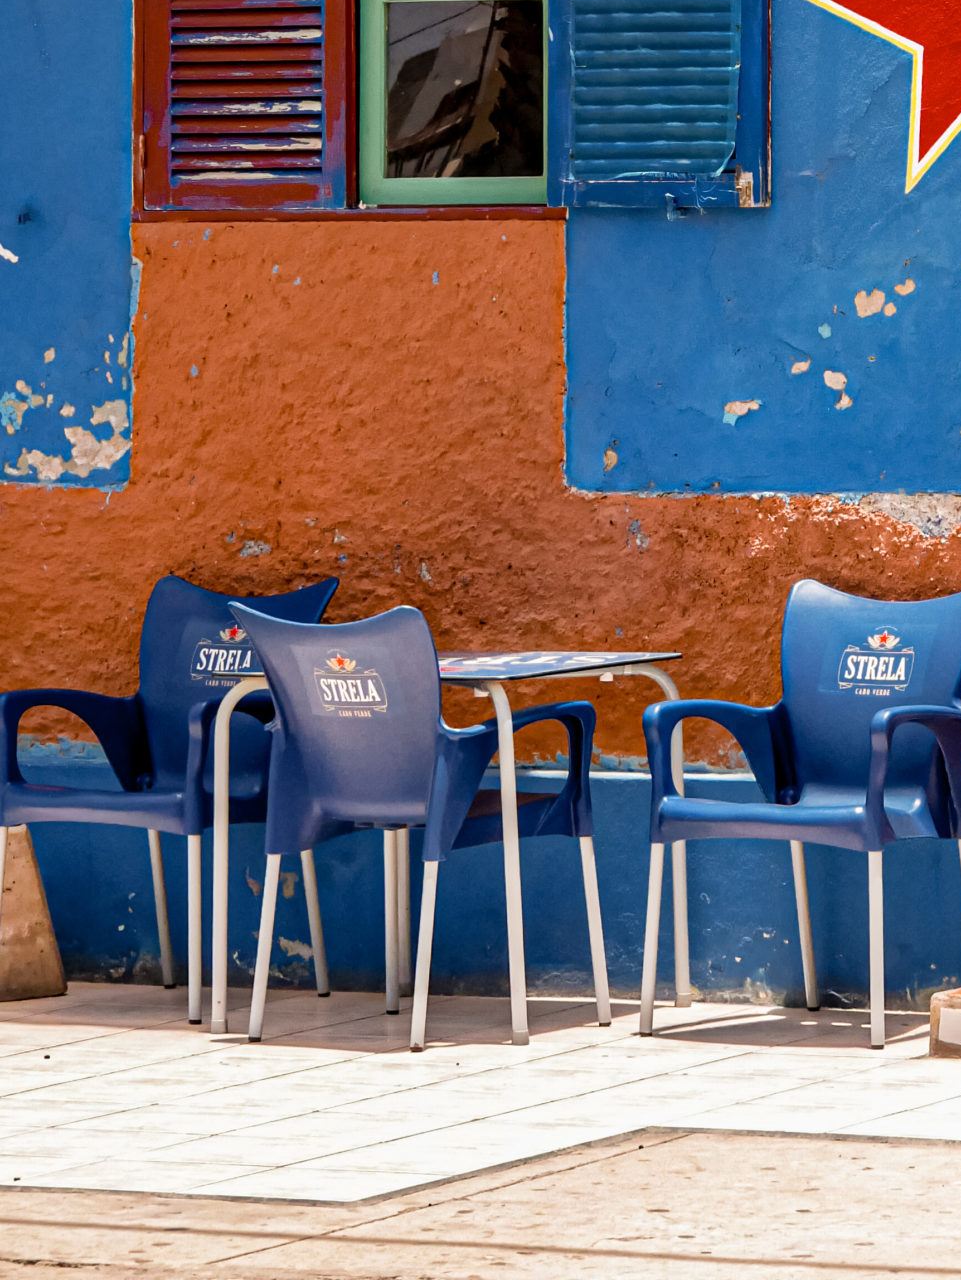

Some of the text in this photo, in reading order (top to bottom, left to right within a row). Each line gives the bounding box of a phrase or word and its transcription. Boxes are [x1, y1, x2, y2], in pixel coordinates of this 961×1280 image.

[196, 648, 252, 671] STRELA
[844, 655, 906, 681] STRELA
[320, 678, 381, 702] STRELA
